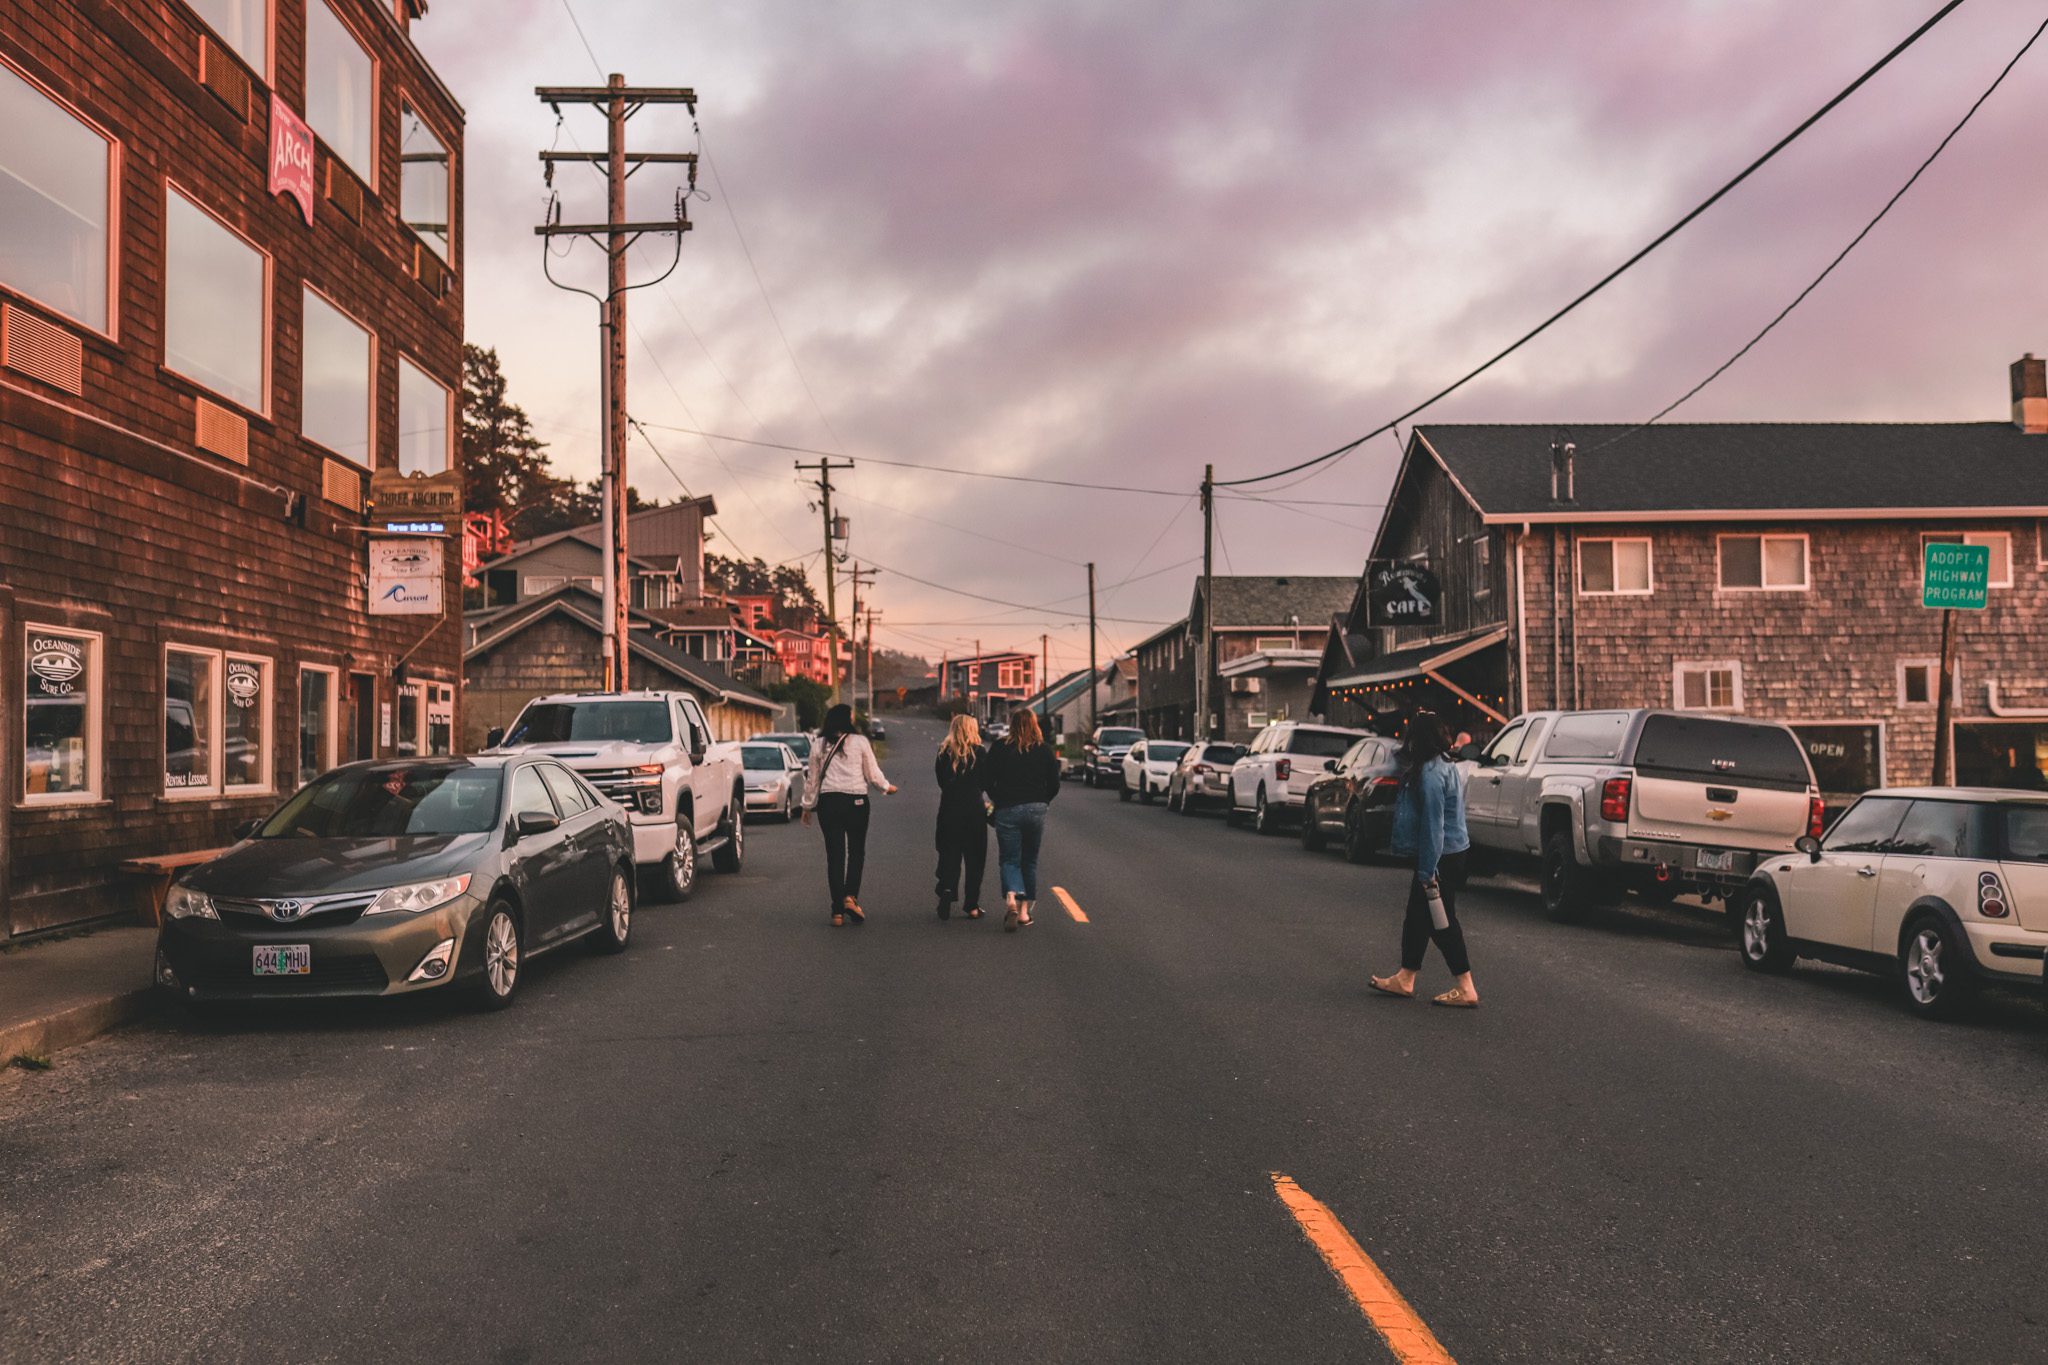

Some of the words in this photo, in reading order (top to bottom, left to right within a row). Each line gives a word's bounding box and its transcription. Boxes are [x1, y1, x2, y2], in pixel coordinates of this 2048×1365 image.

[273, 126, 311, 178] ARCH
[381, 492, 408, 506] THREE
[411, 492, 436, 505] ARCH
[1931, 552, 1969, 565] ADOPT
[1929, 570, 1982, 582] HIGHWAY
[1926, 587, 1984, 600] PROGRAM
[33, 638, 81, 659] OCEANSIDE
[228, 662, 259, 680] OCEANSIDE
[40, 678, 59, 695] SURF
[1810, 743, 1845, 757] OPEN
[188, 771, 208, 786] LESSONS
[255, 953, 277, 968] 644
[285, 951, 307, 968] MHU
